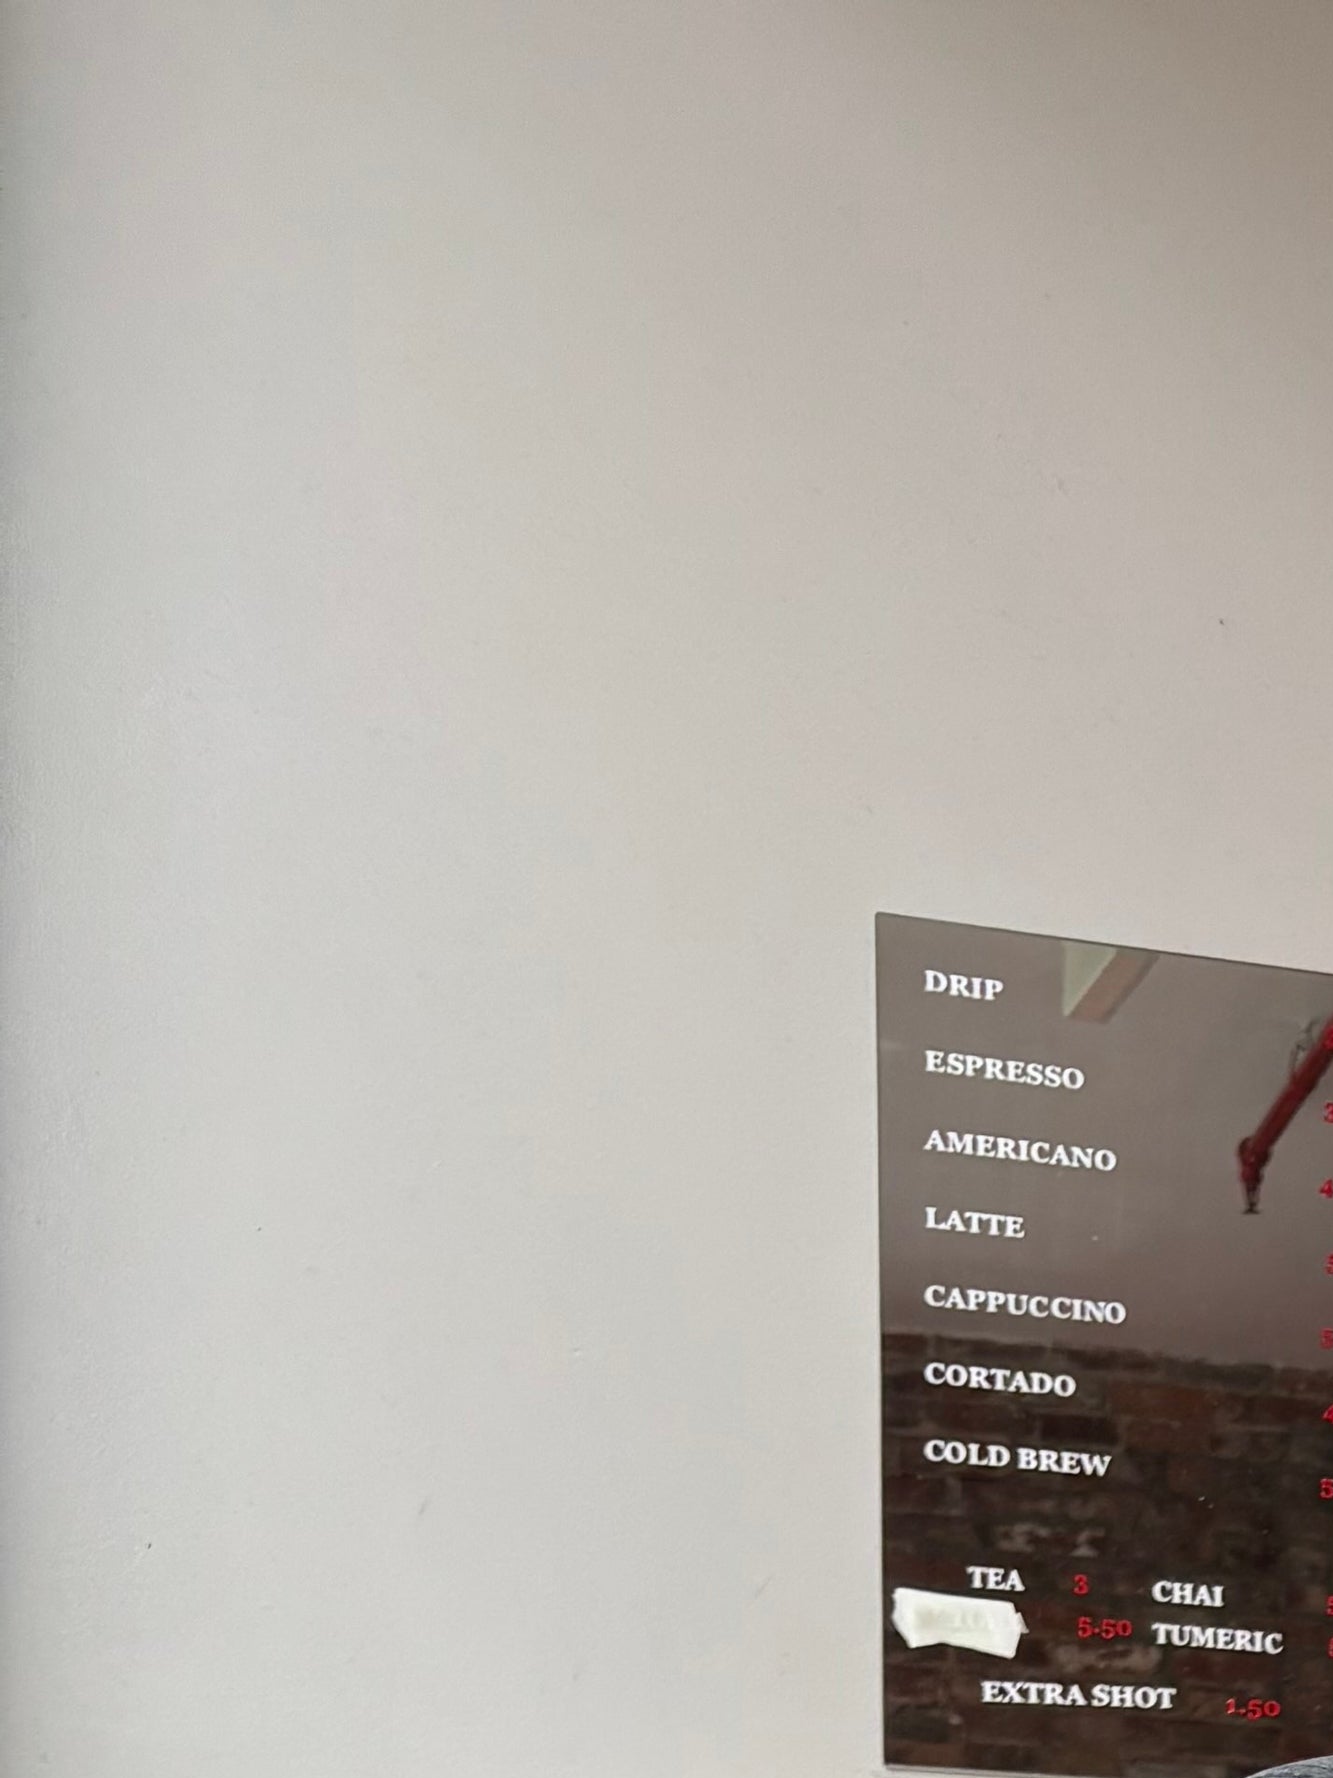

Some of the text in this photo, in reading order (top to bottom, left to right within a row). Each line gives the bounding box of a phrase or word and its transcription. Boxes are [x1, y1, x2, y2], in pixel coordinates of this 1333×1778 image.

[925, 970, 1003, 1000] DRIP
[926, 1051, 1084, 1088] ESPRESSO
[924, 1130, 1116, 1170] AMERICANO
[1321, 1180, 1333, 1196] 4
[926, 1207, 1024, 1237] LATTE
[925, 1285, 1125, 1323] CAPPUCCINO
[925, 1363, 1075, 1396] CORTADO
[924, 1440, 1111, 1476] COLD BREW
[967, 1566, 1024, 1591] TEA
[1074, 1575, 1088, 1595] 3
[1153, 1581, 1223, 1606] CHAI
[1152, 1623, 1282, 1654] TUMERIC
[981, 1681, 1177, 1710] EXTRA SHOT
